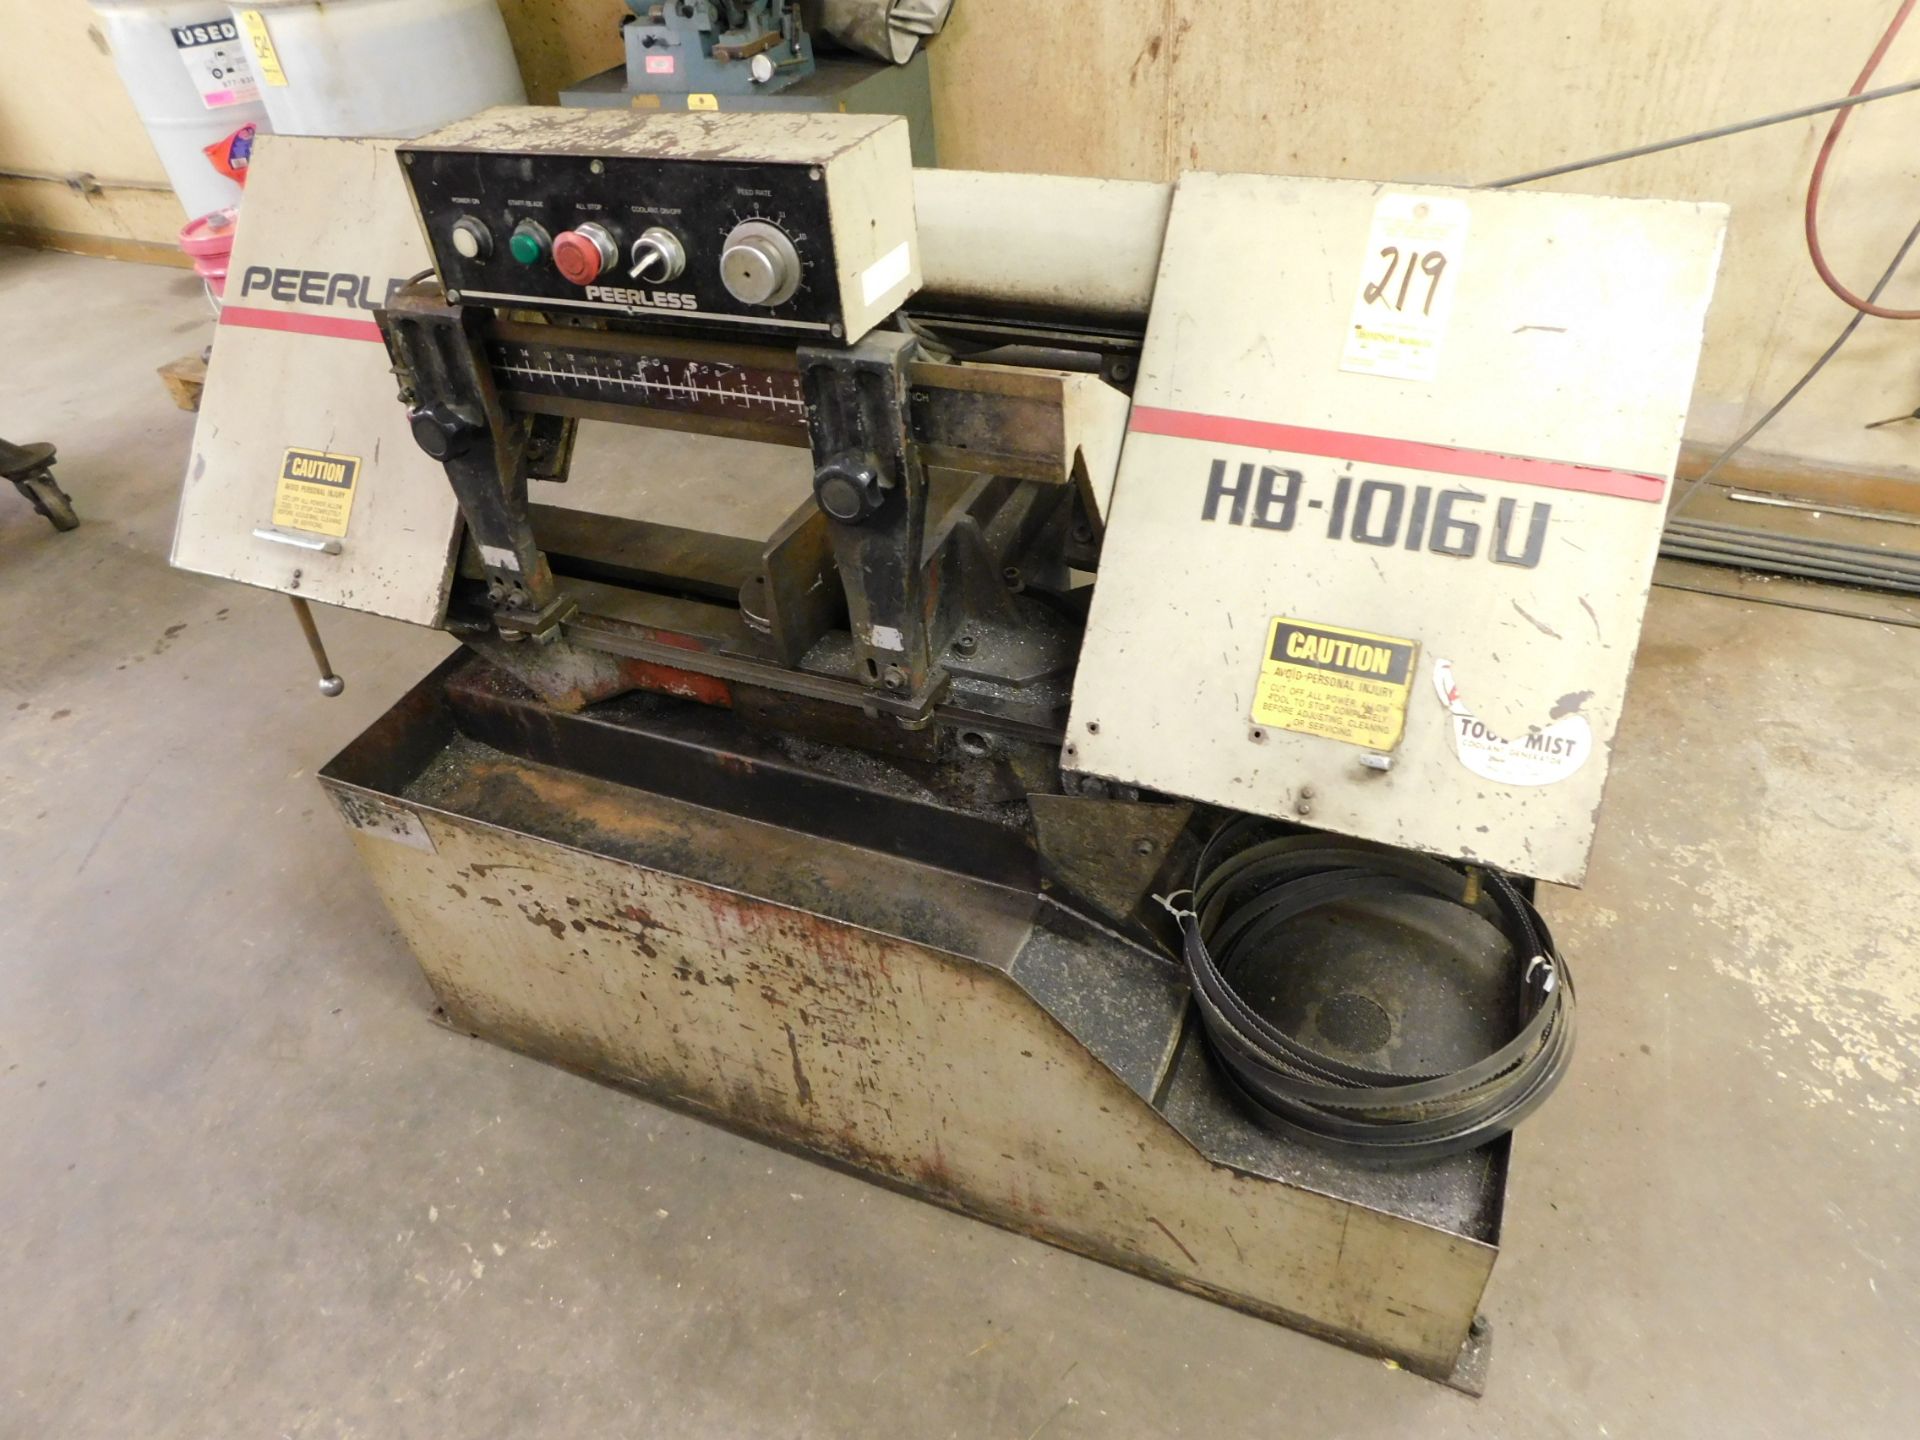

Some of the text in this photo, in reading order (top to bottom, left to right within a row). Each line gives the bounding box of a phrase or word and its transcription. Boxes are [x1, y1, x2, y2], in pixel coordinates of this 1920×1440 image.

[178, 23, 237, 46] USED
[1363, 246, 1447, 316] 219
[585, 285, 698, 310] PEERLESS
[766, 376, 772, 384] 4
[291, 457, 346, 483] CAUTION
[1200, 458, 1552, 569] HB-1016U
[1286, 631, 1392, 675] CAUTION
[1270, 683, 1287, 694] CUT
[1289, 687, 1305, 697] OFF
[1307, 691, 1322, 701] ALL
[1359, 682, 1394, 699] INJURY
[1262, 702, 1293, 716] BEFORE
[1295, 698, 1305, 708] TO
[1308, 700, 1331, 712] STOP
[1293, 718, 1305, 727] OR
[1525, 733, 1577, 757] MIST
